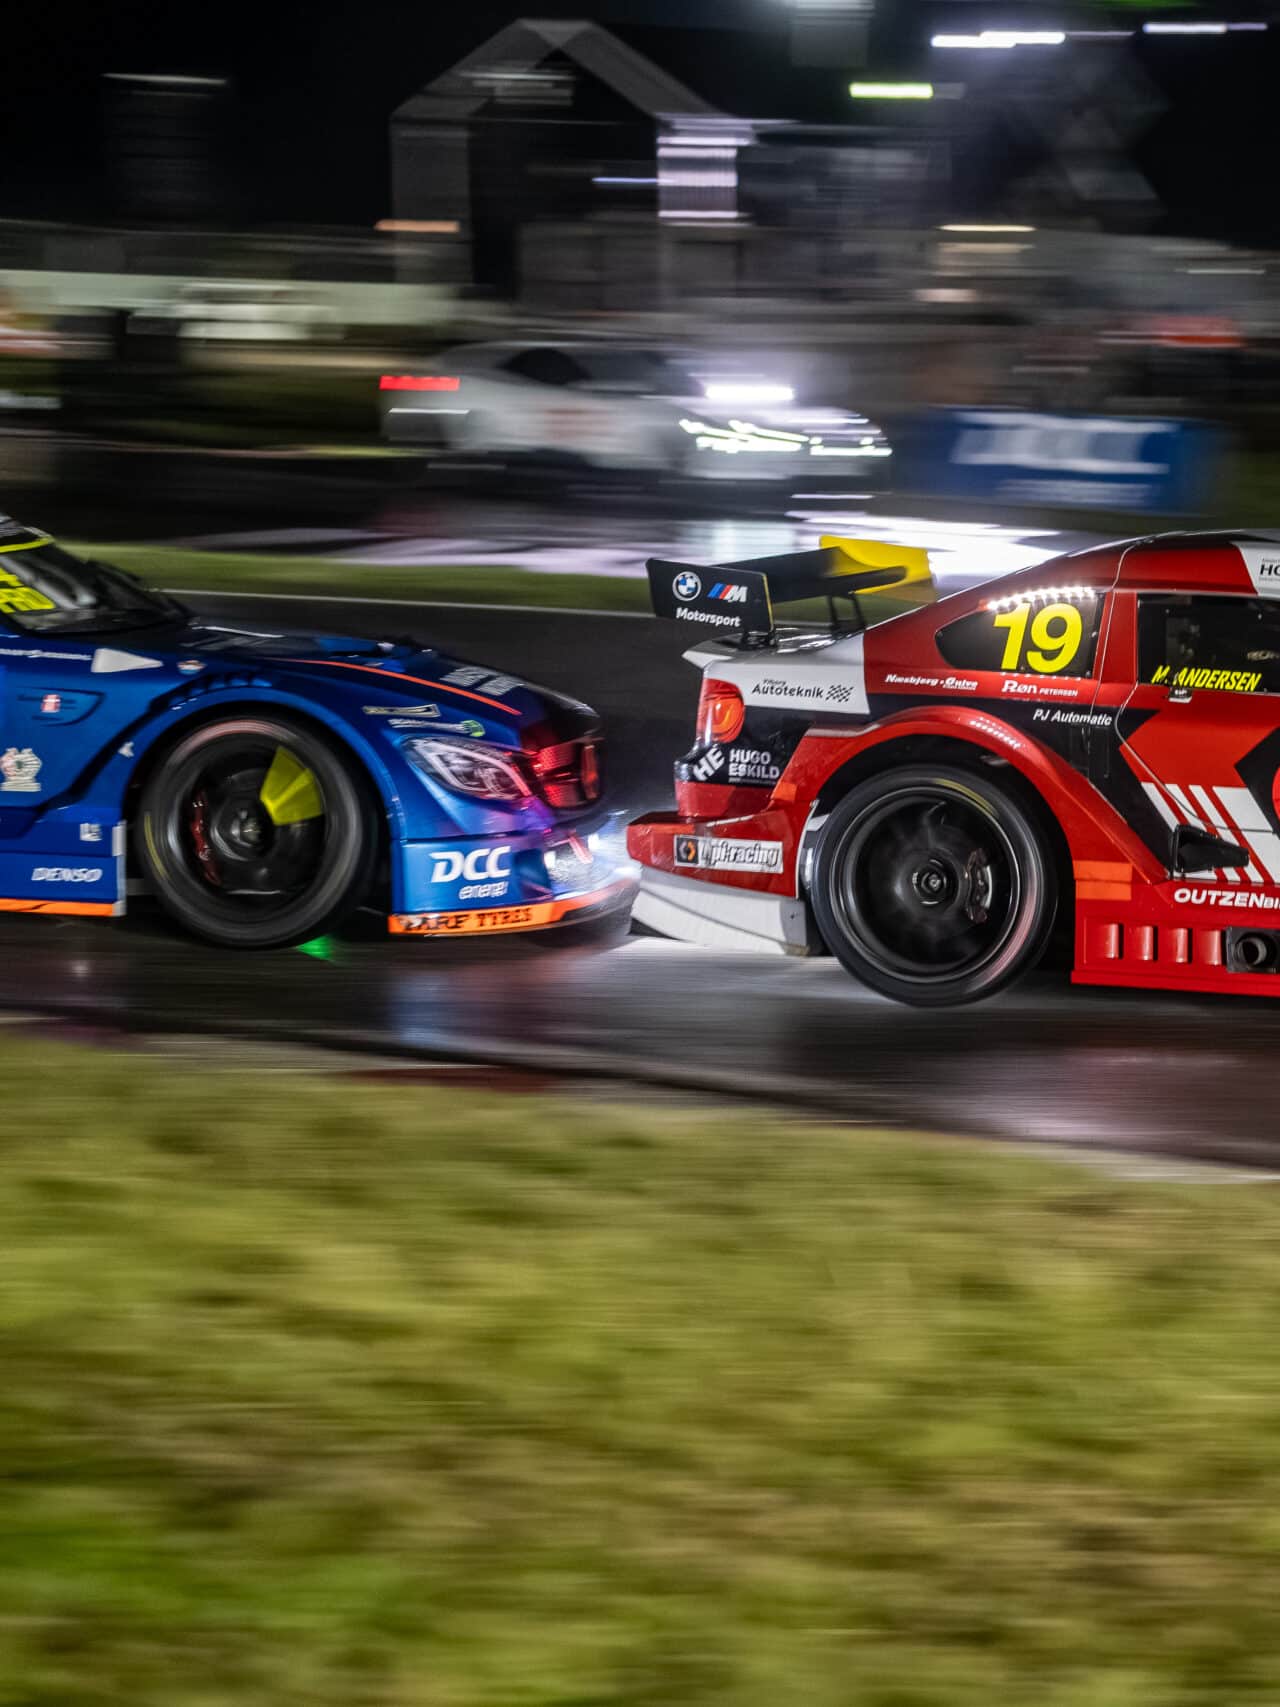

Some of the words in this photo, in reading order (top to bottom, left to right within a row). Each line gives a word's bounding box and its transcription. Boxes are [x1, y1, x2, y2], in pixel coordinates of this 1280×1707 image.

[676, 607, 741, 627] Motorsport
[993, 602, 1082, 673] 19
[1151, 665, 1170, 684] M.
[1173, 667, 1262, 692] ANDERSEN
[752, 683, 824, 699] Autoteknik
[1001, 680, 1037, 693] Røn
[1040, 688, 1078, 697] PETERSEN
[1033, 709, 1048, 721] PJ
[1051, 710, 1112, 726] Automatic
[693, 745, 725, 781] HE
[730, 749, 771, 764] HUGO
[728, 763, 780, 779] ESKILD
[429, 846, 512, 883] DCC
[31, 867, 103, 882] DENSO
